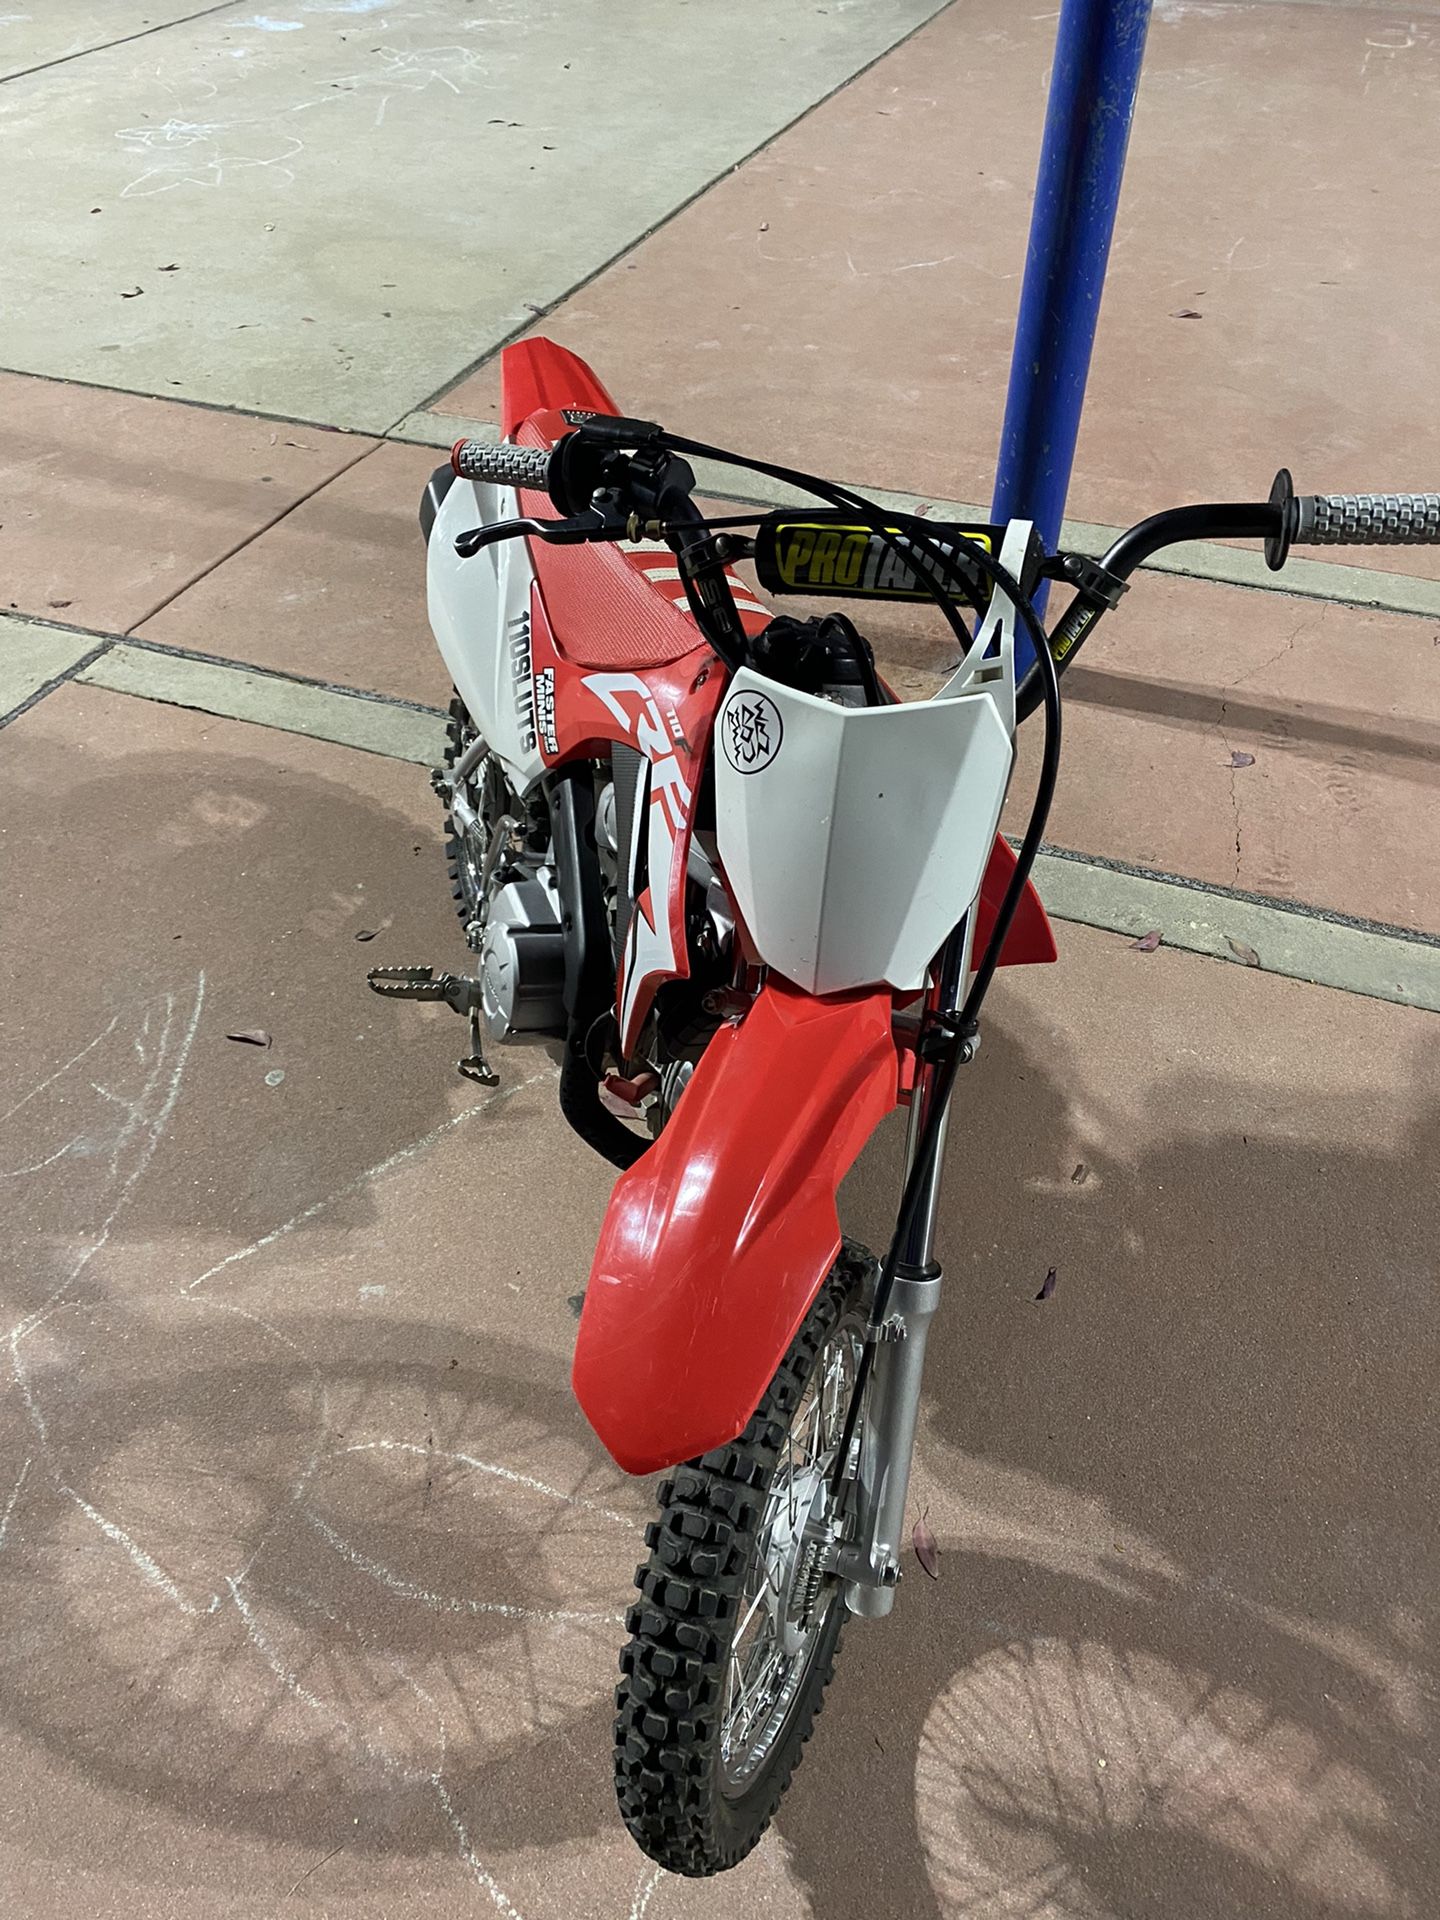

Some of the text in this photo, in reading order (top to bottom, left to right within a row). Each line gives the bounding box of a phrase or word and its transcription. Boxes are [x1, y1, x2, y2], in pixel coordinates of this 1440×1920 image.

[508, 611, 536, 753] 110SLUTS
[543, 668, 559, 753] FASTER
[580, 673, 692, 829] CRF
